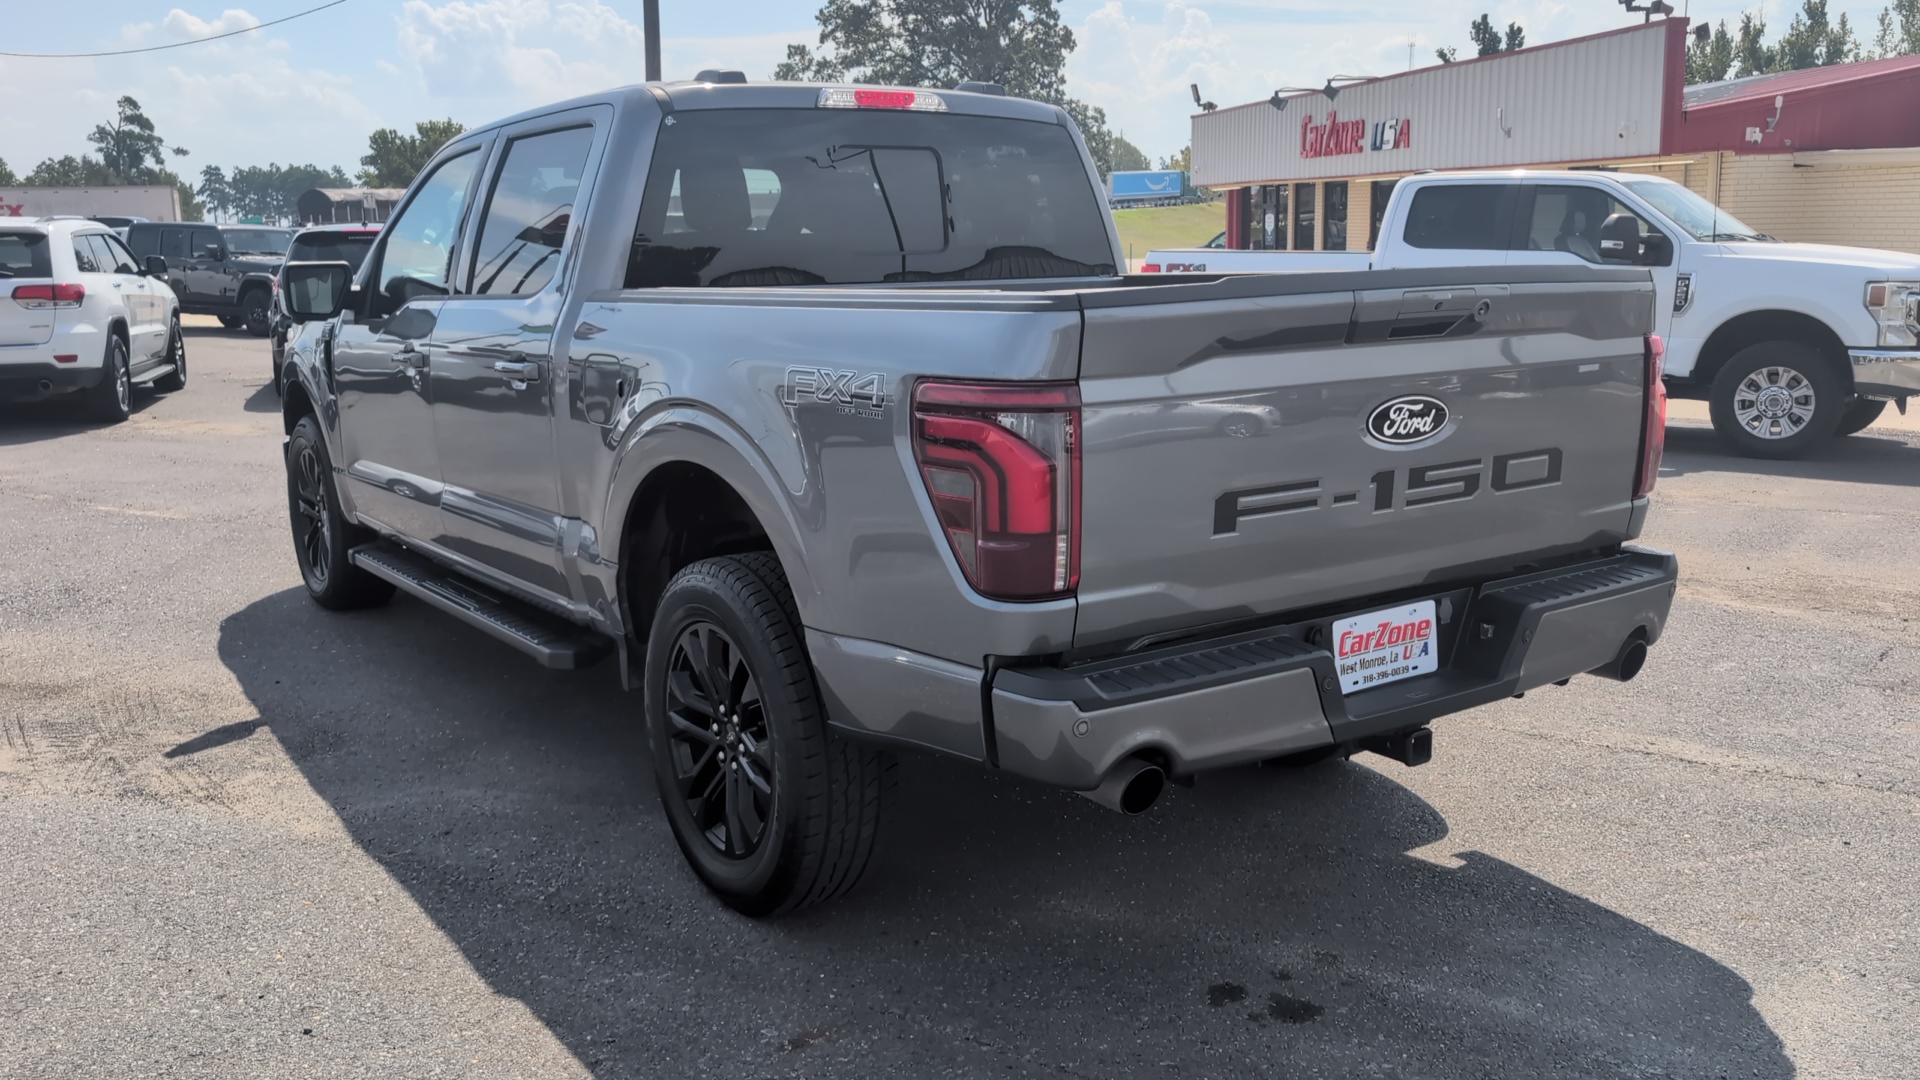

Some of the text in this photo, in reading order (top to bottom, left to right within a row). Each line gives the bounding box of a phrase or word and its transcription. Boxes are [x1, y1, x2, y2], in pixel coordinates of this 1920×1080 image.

[1301, 110, 1410, 158] CarZone USA
[784, 365, 886, 410] FX4
[836, 406, 884, 419] OFF ROAD
[1383, 402, 1435, 436] Ford
[1211, 447, 1563, 538] F-150
[1339, 619, 1432, 660] CarZone
[1340, 651, 1398, 676] West Monroe, La
[1362, 665, 1409, 684] 318-396-0039
